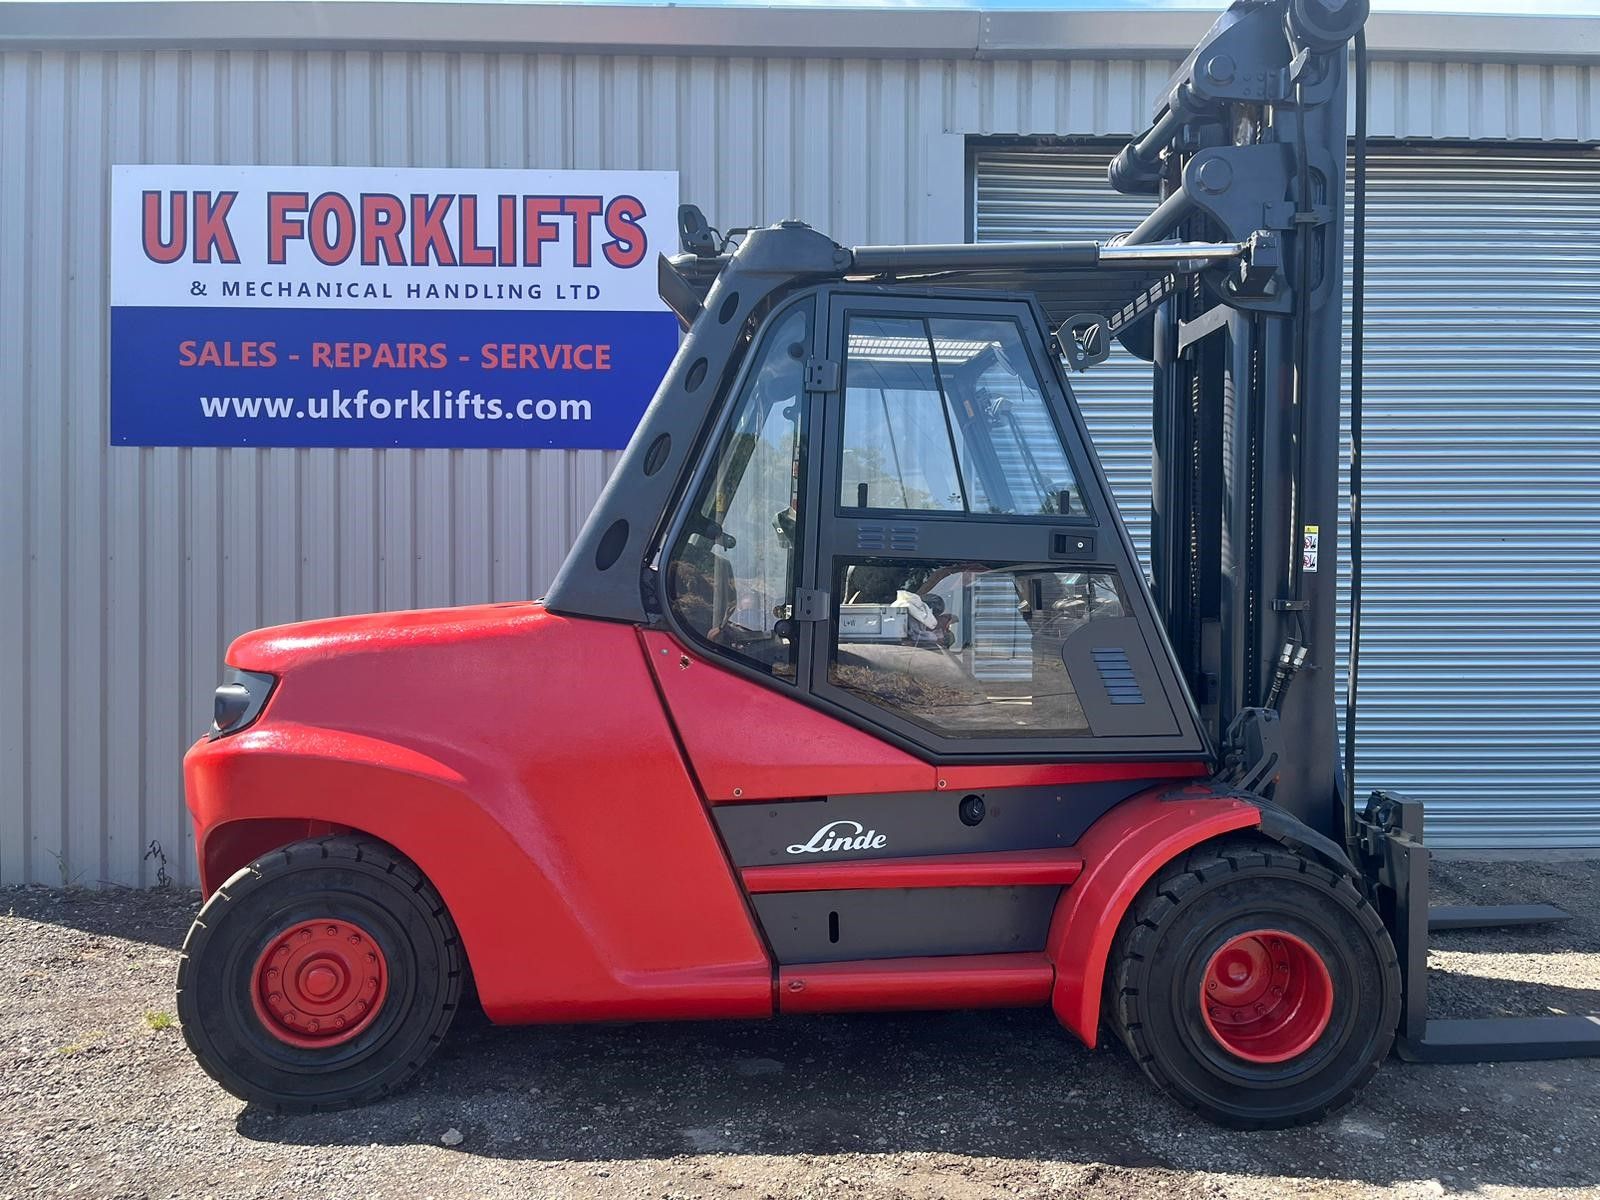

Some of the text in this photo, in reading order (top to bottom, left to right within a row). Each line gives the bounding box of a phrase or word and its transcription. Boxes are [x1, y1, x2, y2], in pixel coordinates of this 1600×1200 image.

[142, 190, 648, 269] UK FORKLIFTS
[190, 281, 601, 300] & MECHANICAL HANDLING LTD
[179, 341, 277, 367] SALES
[312, 342, 448, 369] REPAIRS
[481, 343, 611, 370] SERVICE
[200, 389, 592, 420] www.ukforklifts.com
[786, 820, 887, 854] Linde
